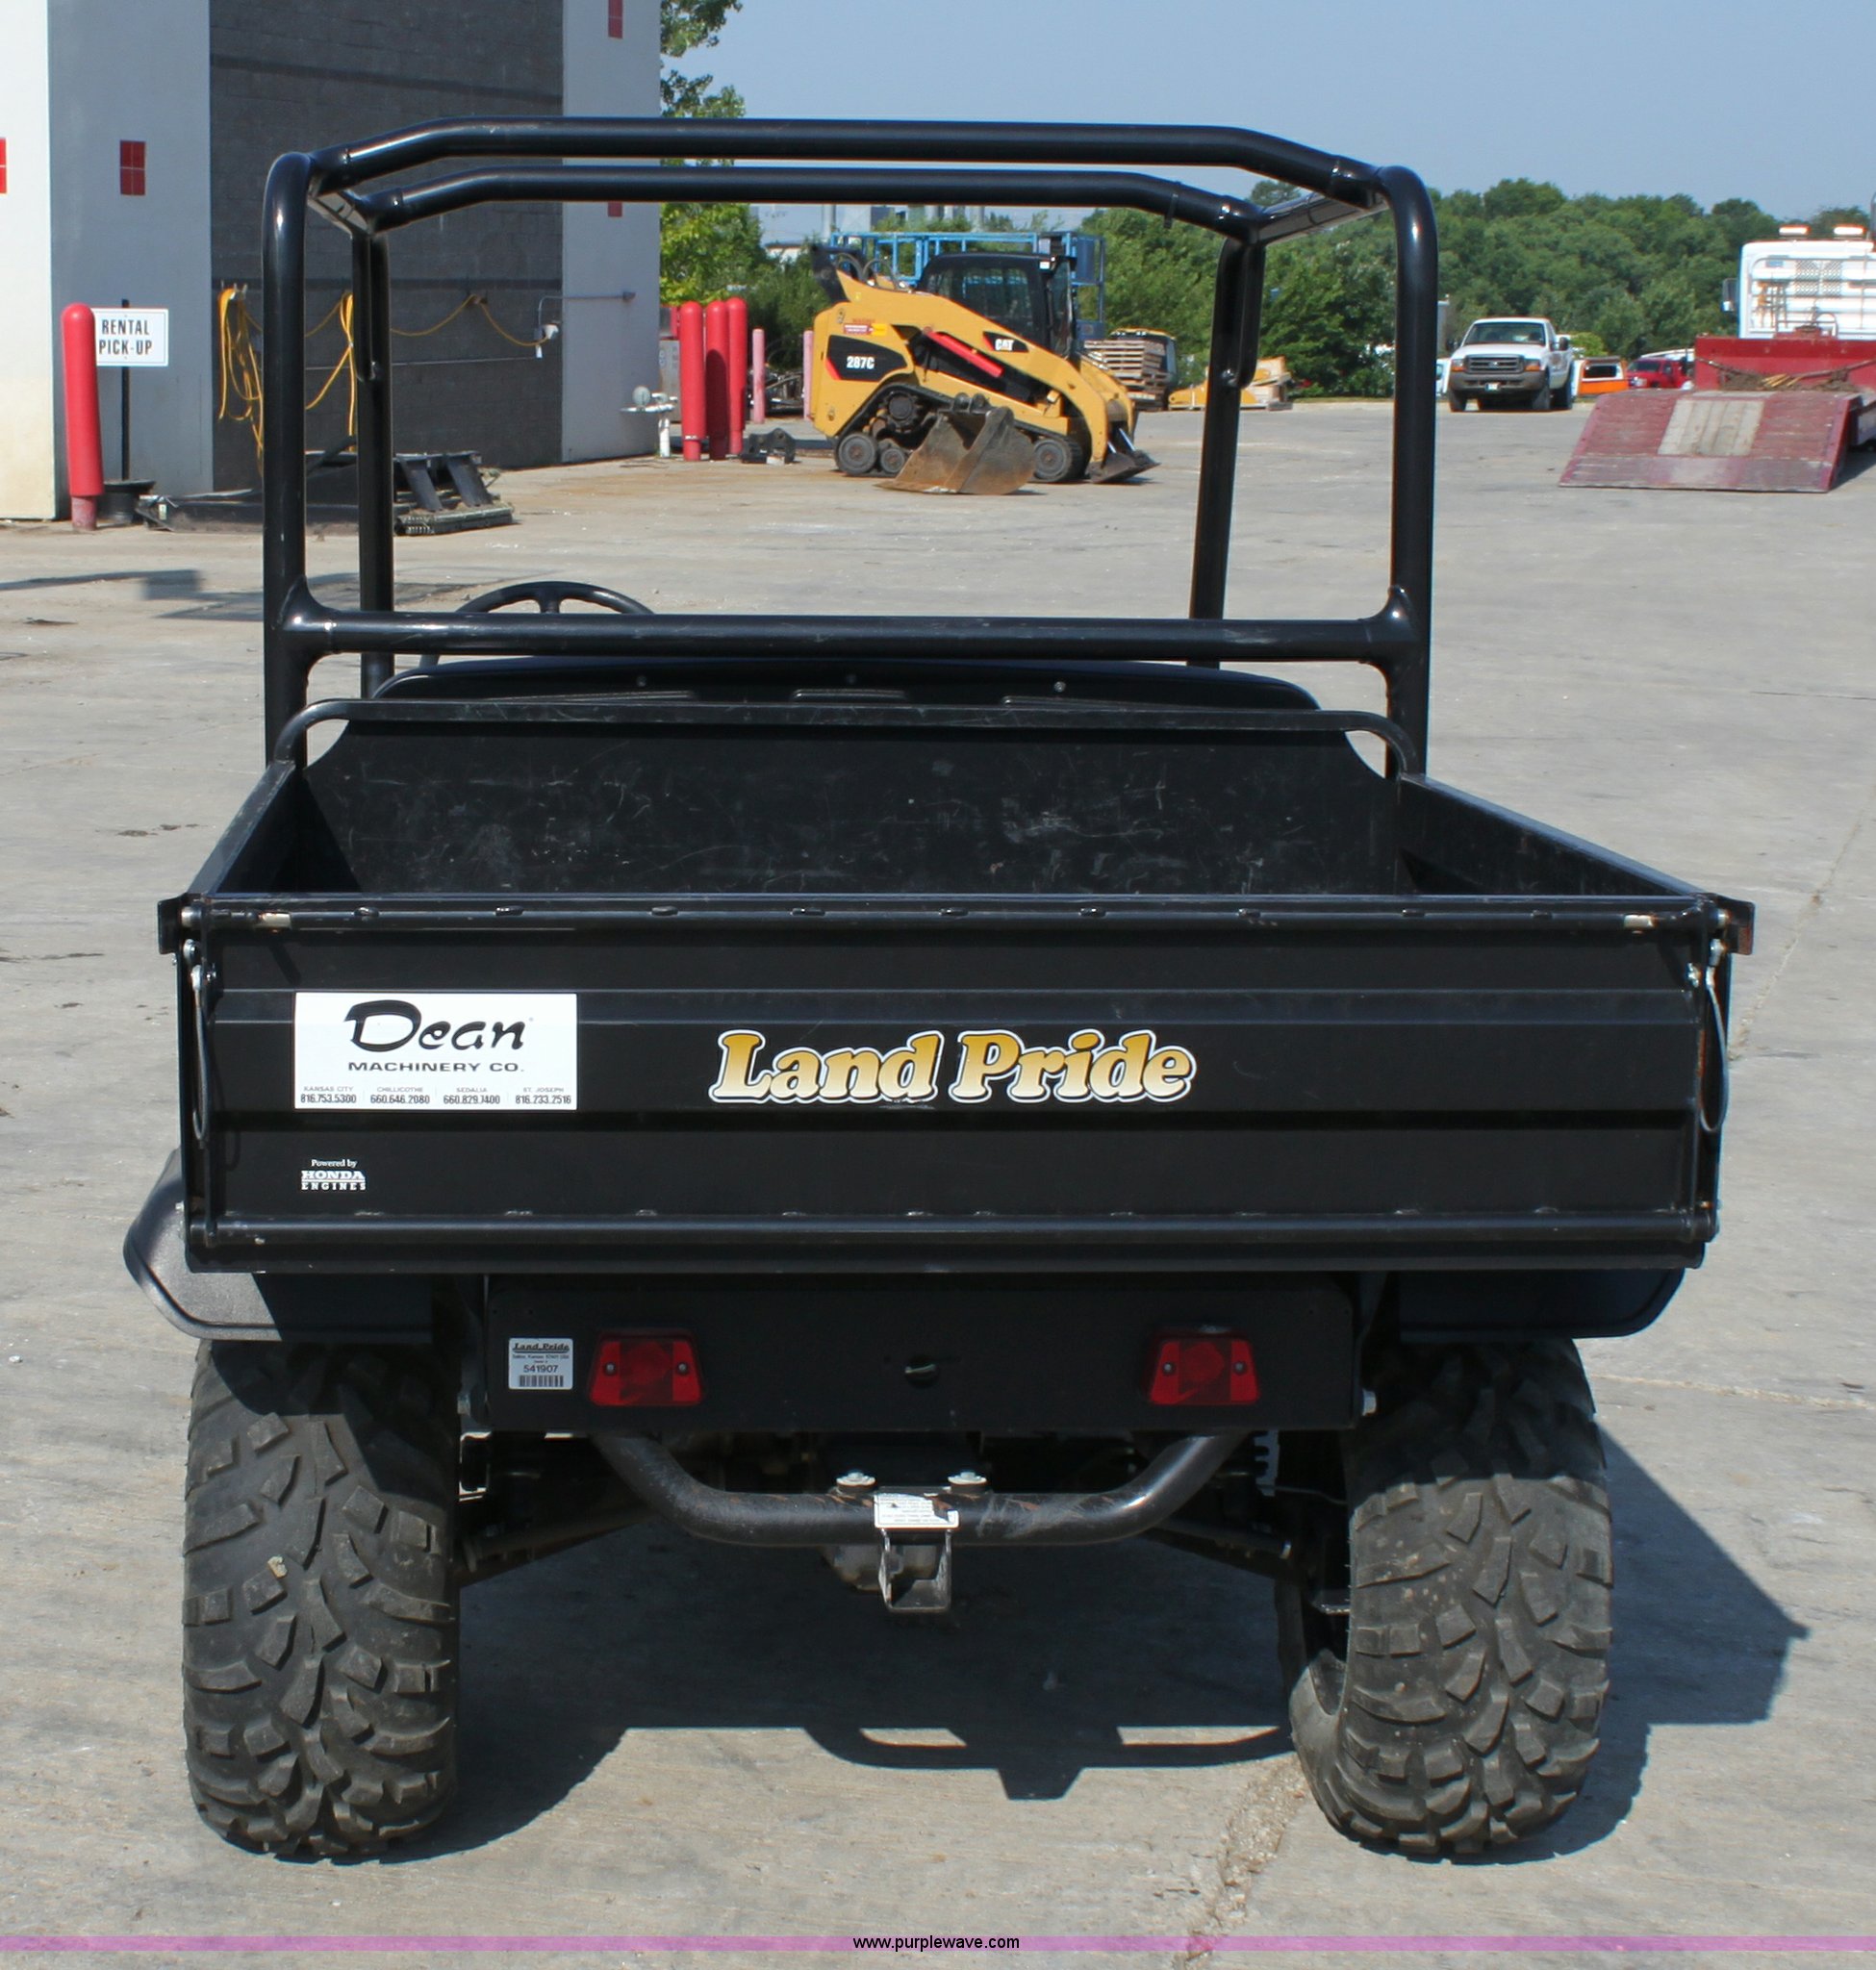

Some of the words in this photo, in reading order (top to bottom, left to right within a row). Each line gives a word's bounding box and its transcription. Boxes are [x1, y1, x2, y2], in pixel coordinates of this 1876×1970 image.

[102, 319, 150, 336] RENTAL
[99, 340, 153, 355] PICK-UP
[995, 338, 1015, 351] CAT
[847, 355, 875, 369] 287C
[343, 999, 525, 1052] Dean
[347, 1061, 481, 1073] MACHINERY
[489, 1061, 525, 1073] CO.
[708, 1028, 944, 1103] Land
[949, 1028, 1196, 1103] Pride
[311, 1158, 346, 1167] Powered
[346, 1158, 358, 1169] by
[301, 1170, 366, 1179] HONDA
[301, 1182, 366, 1191] ENGINES
[523, 1365, 559, 1374] 541907
